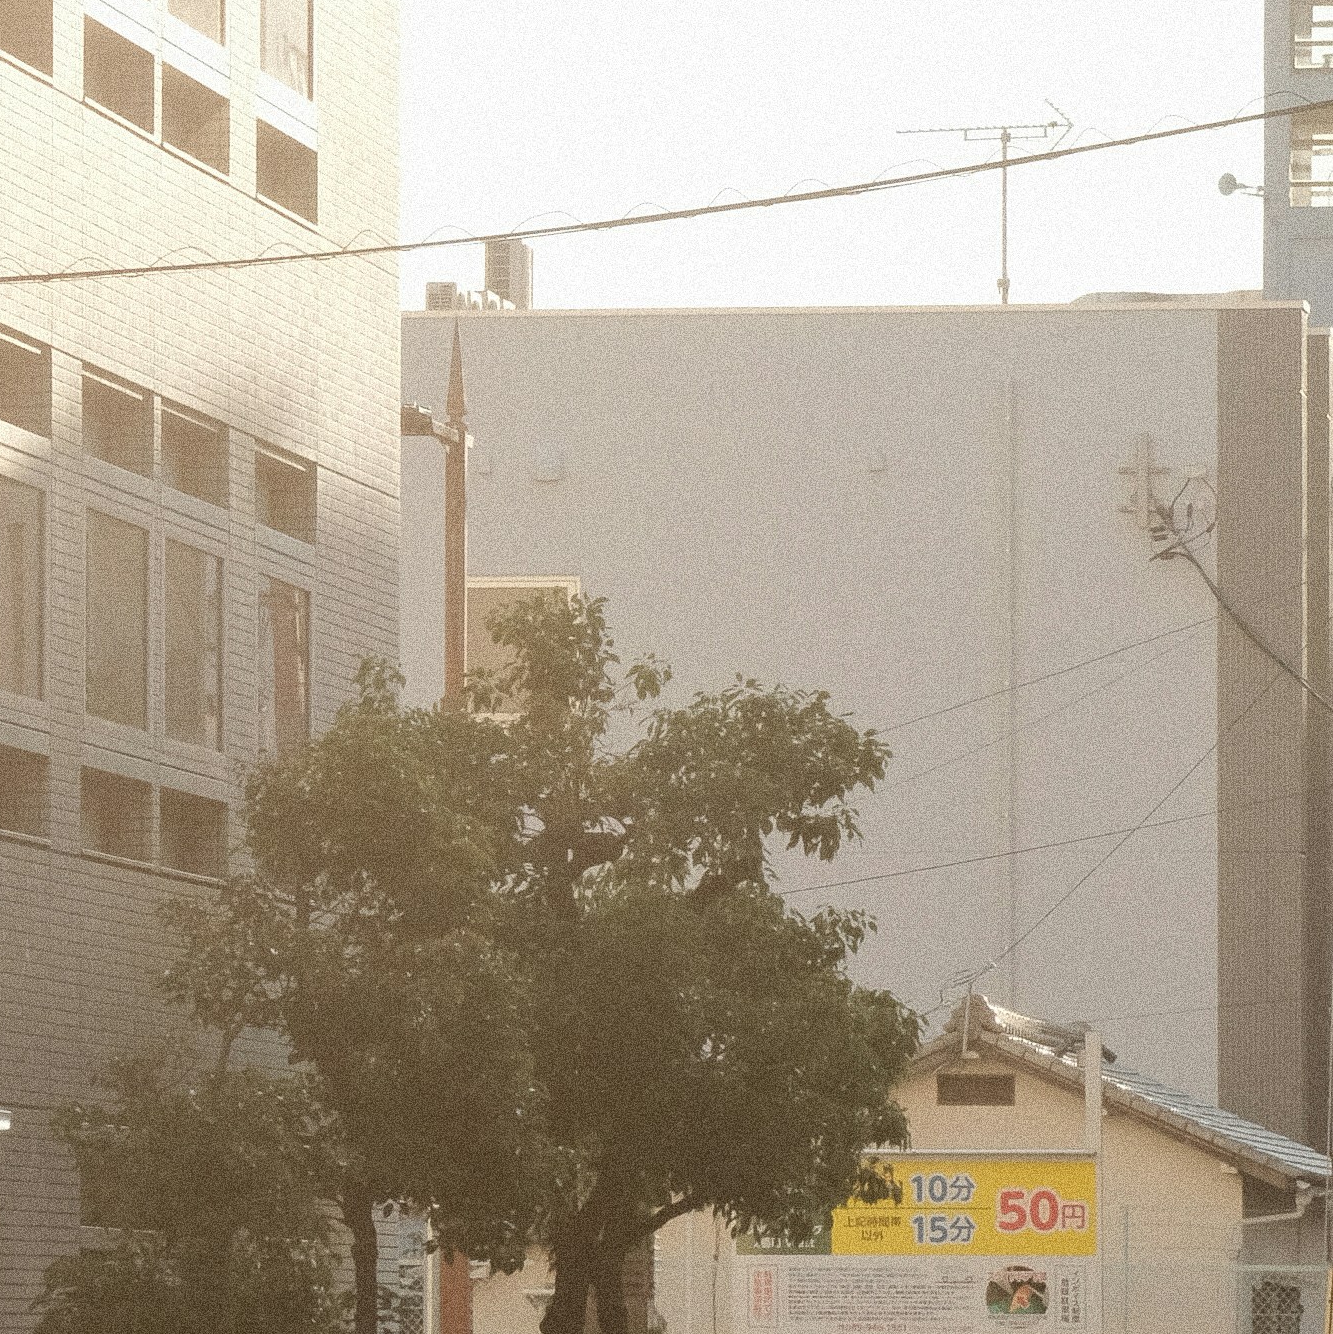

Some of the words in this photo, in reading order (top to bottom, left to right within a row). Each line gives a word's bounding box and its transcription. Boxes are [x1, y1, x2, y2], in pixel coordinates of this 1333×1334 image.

[911, 1174, 976, 1203] 10分
[998, 1190, 1086, 1231] 50円
[861, 1230, 884, 1241] 以外
[911, 1215, 976, 1244] 15分
